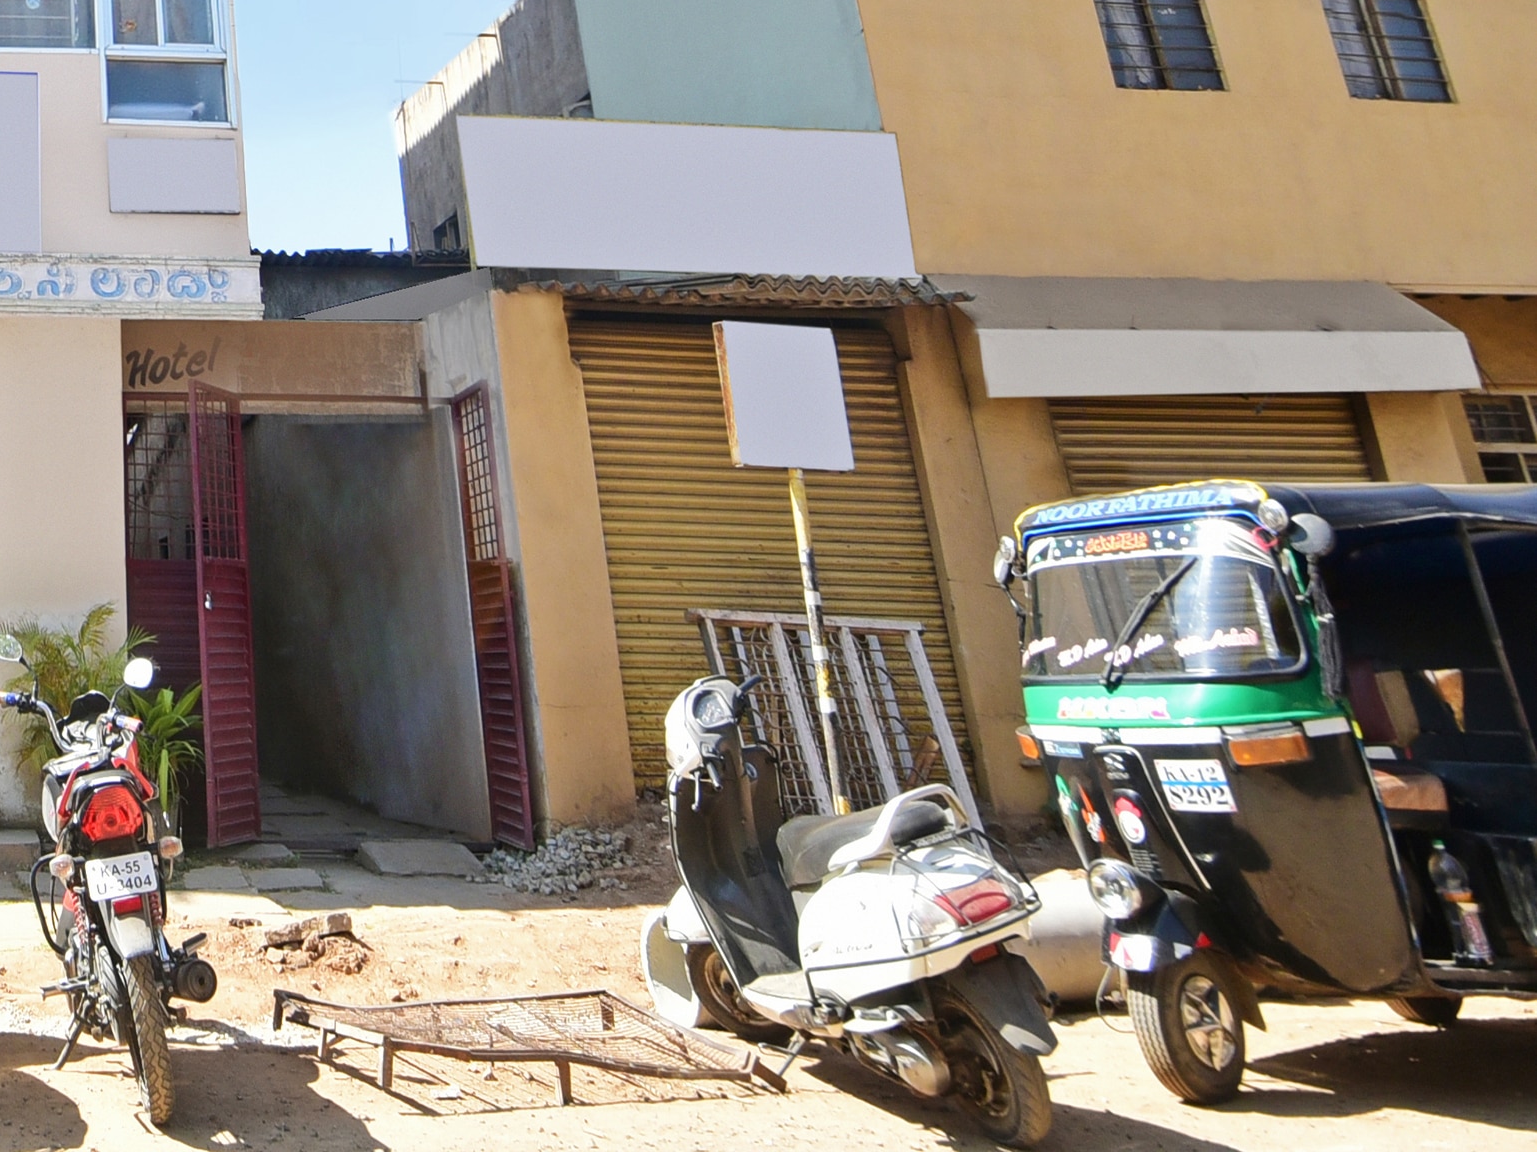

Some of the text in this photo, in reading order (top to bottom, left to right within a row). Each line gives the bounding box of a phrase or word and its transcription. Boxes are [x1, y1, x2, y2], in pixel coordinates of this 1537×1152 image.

[125, 336, 220, 389] Hotel
[1034, 487, 1233, 525] NOOR FATHIMA
[1167, 784, 1231, 805] 8292
